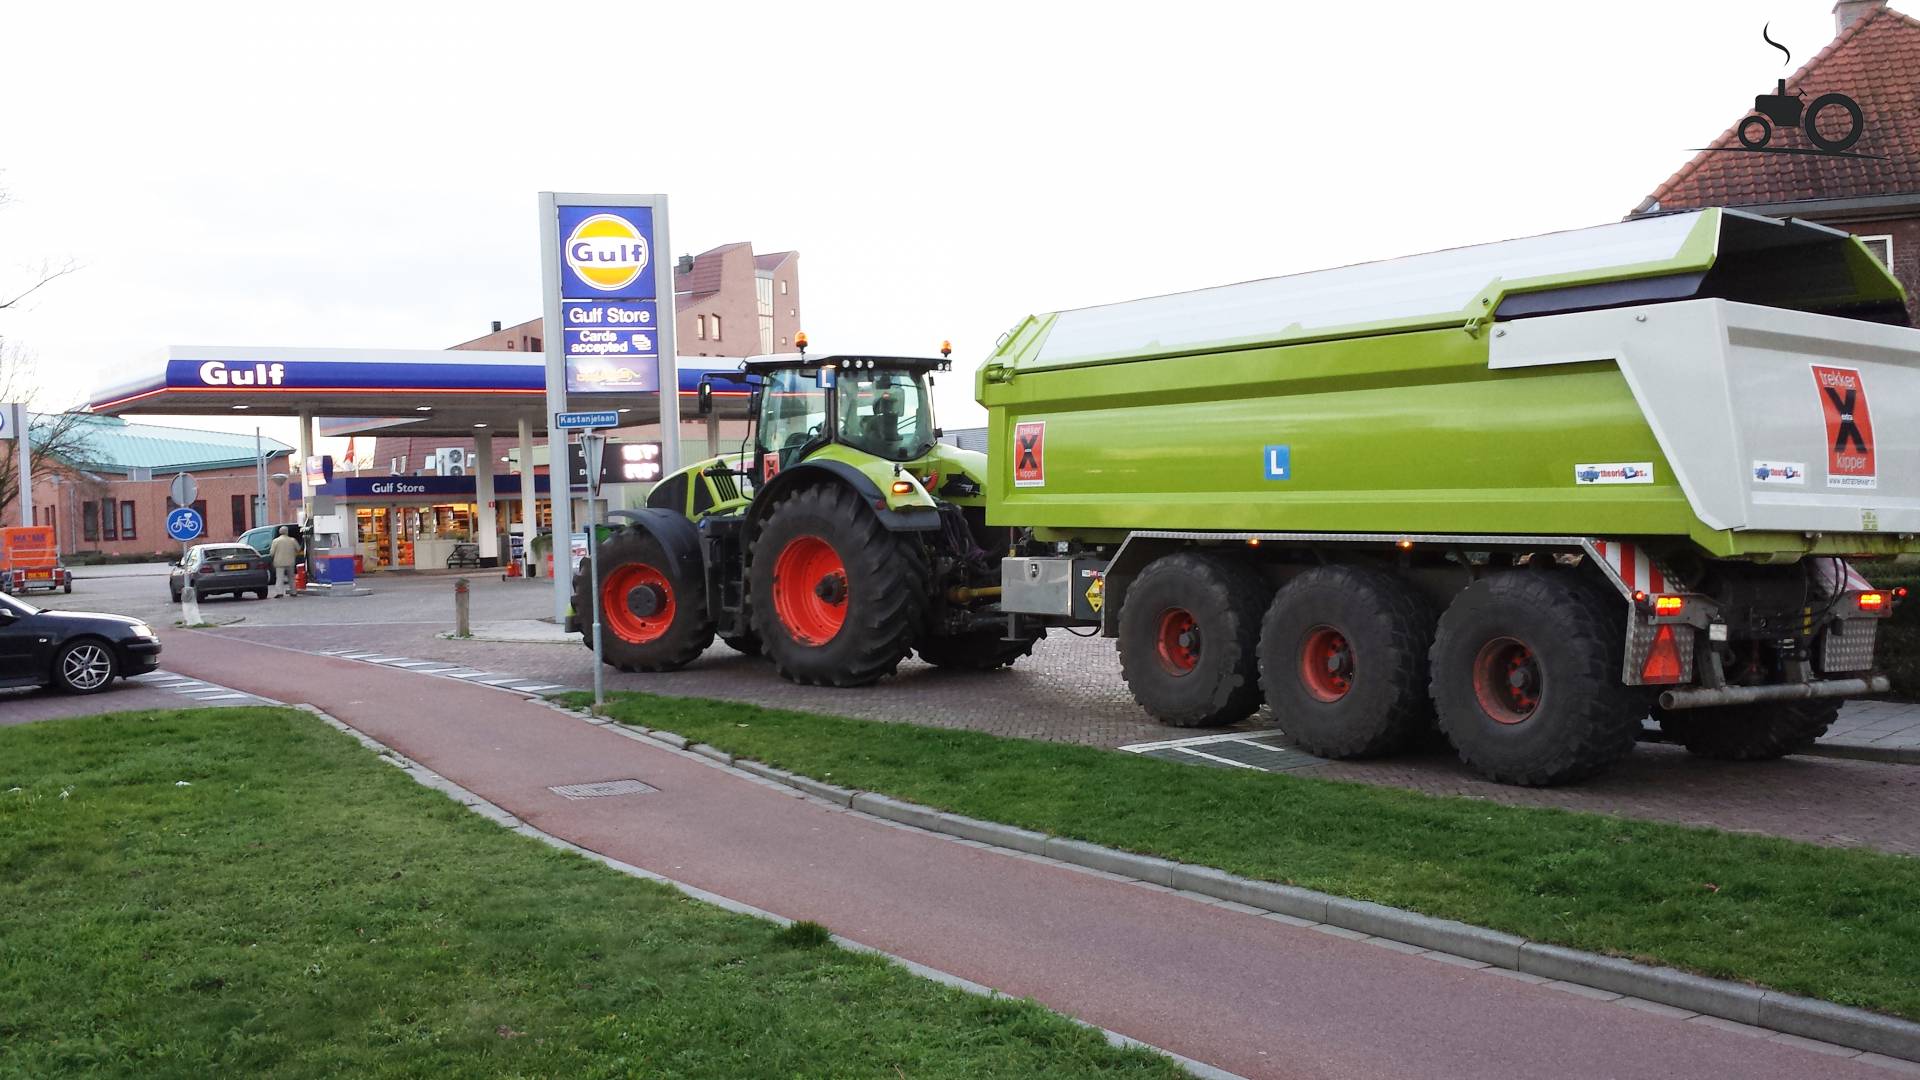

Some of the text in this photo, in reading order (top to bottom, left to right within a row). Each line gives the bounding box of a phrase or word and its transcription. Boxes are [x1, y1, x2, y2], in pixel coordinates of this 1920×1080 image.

[571, 242, 643, 263] Gulf
[569, 307, 650, 324] Gulf Store
[580, 330, 617, 342] Cards
[571, 341, 628, 355] accepted
[199, 360, 285, 386] Gulf
[1818, 370, 1857, 388] trekker
[560, 414, 615, 426] Kastanjelaan
[1271, 450, 1284, 475] L
[1835, 452, 1867, 472] kipper
[372, 482, 425, 494] Gulf Store
